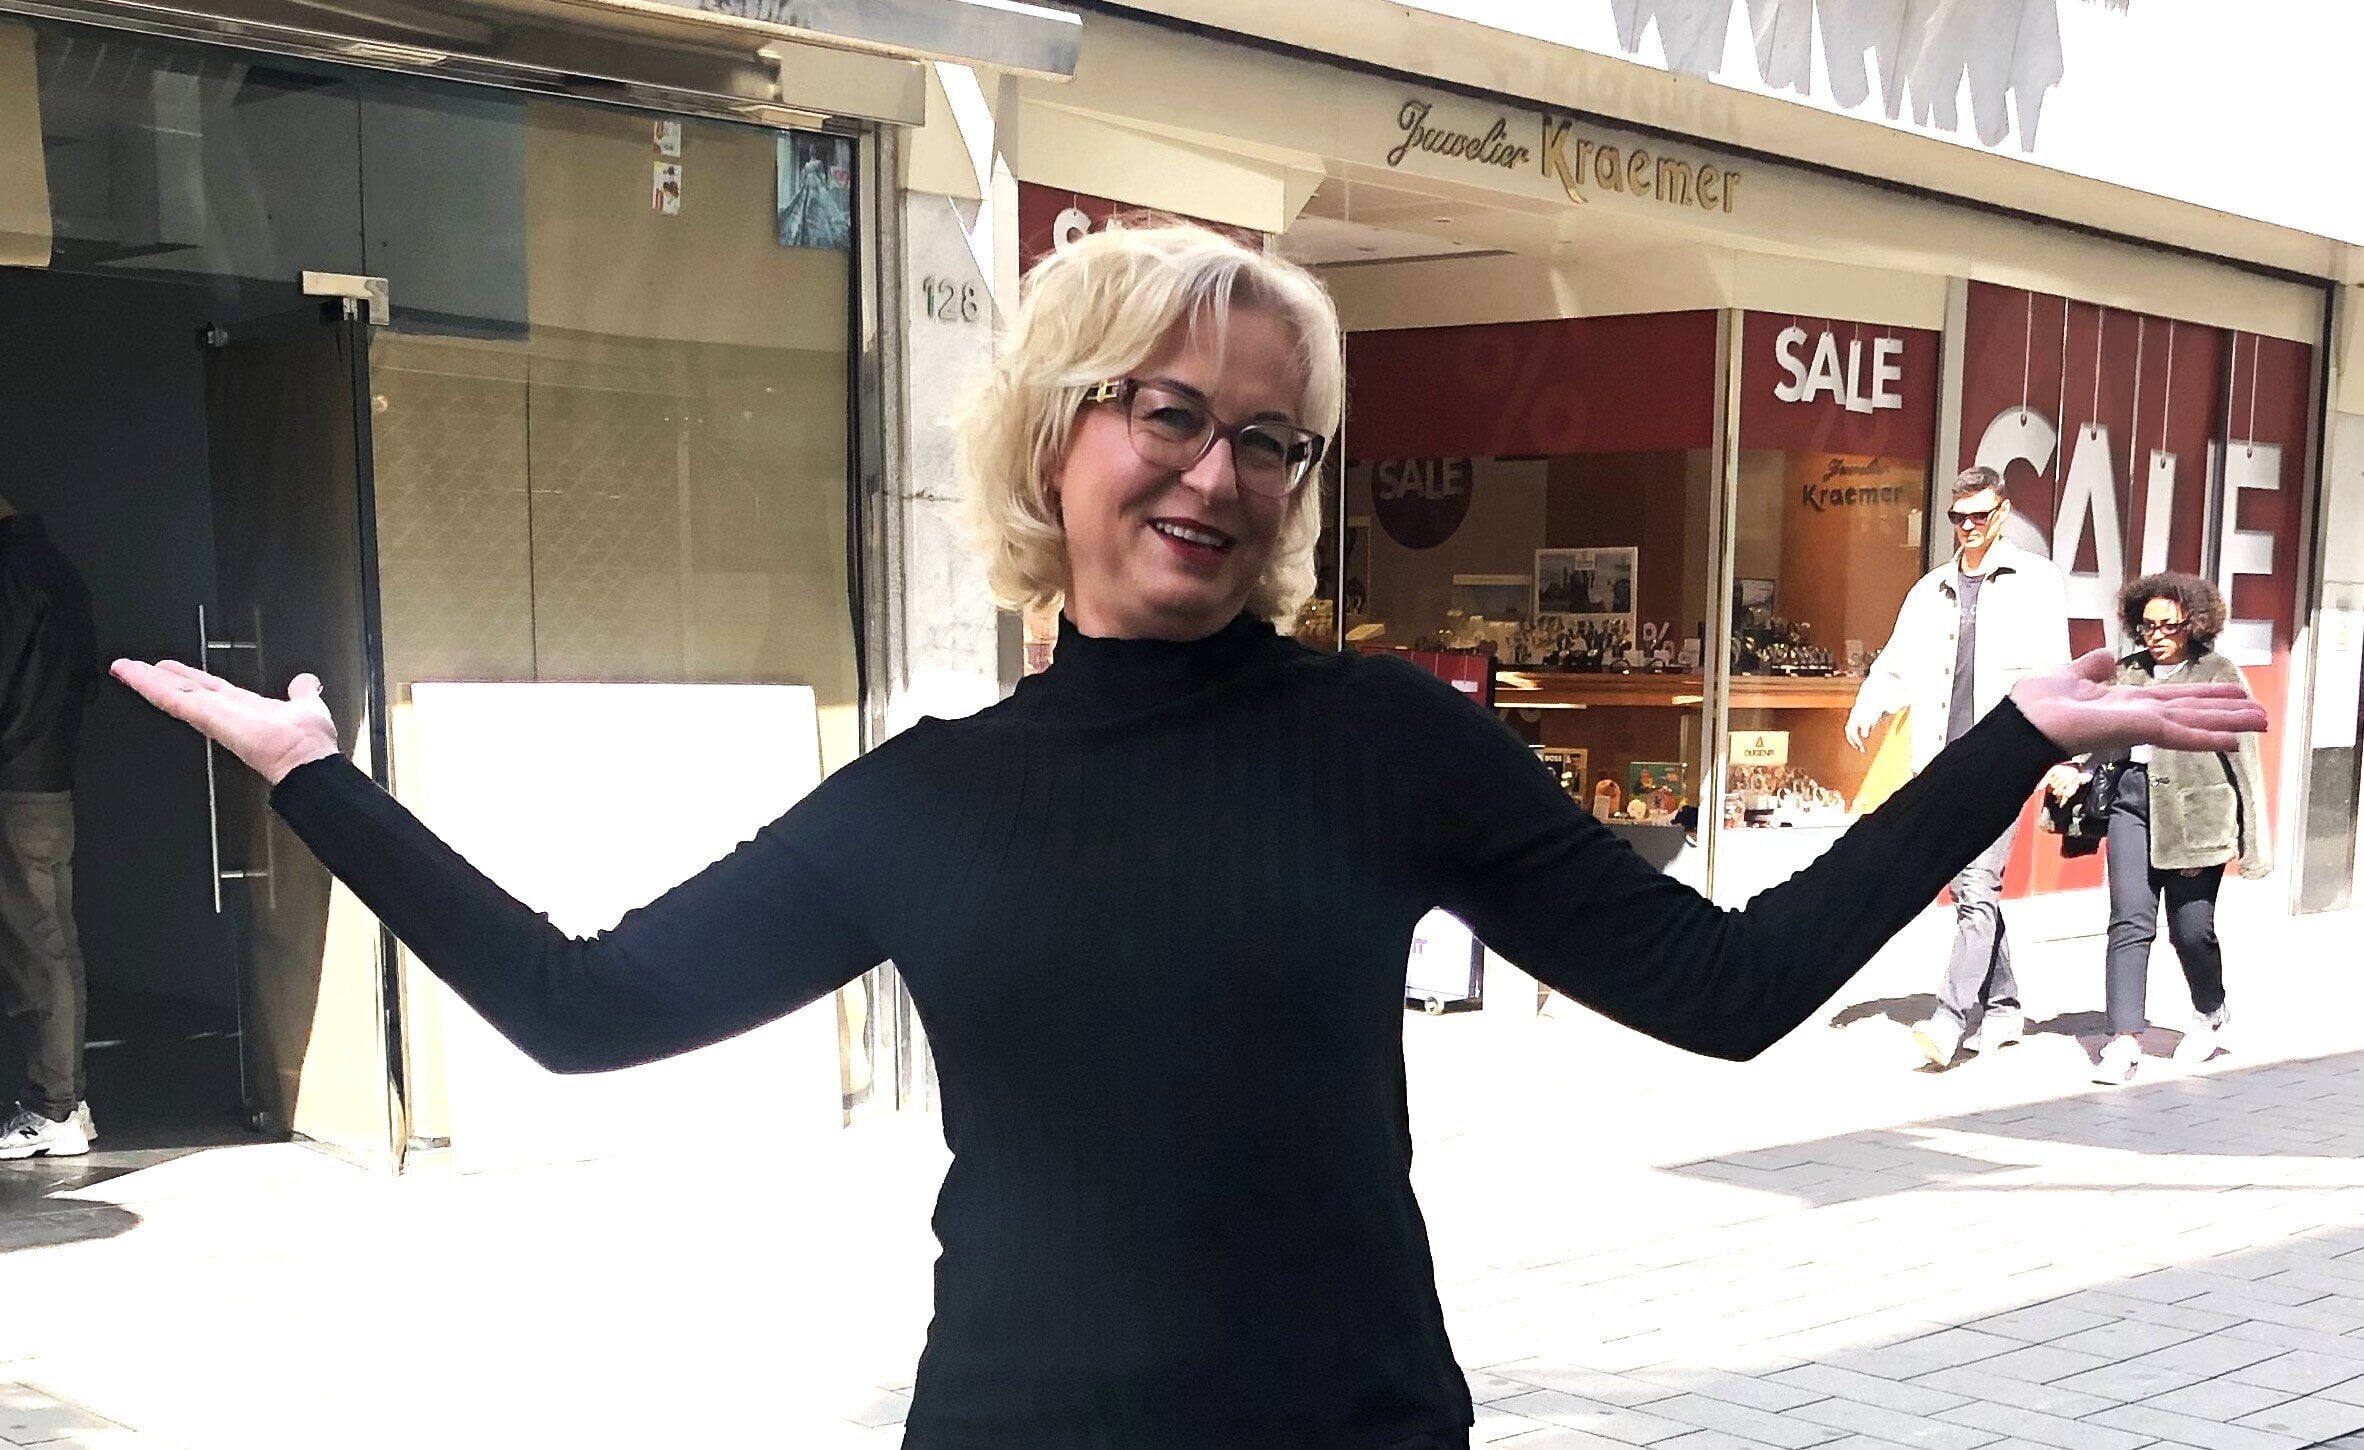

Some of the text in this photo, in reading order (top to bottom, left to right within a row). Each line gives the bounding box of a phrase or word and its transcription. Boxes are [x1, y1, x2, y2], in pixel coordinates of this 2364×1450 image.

[1387, 100, 1742, 213] Juwelier Kraemer
[922, 275, 979, 323] 128
[1774, 326, 1904, 414] SALE
[1380, 457, 1465, 500] SALE
[1801, 484, 1904, 512] Kraemer
